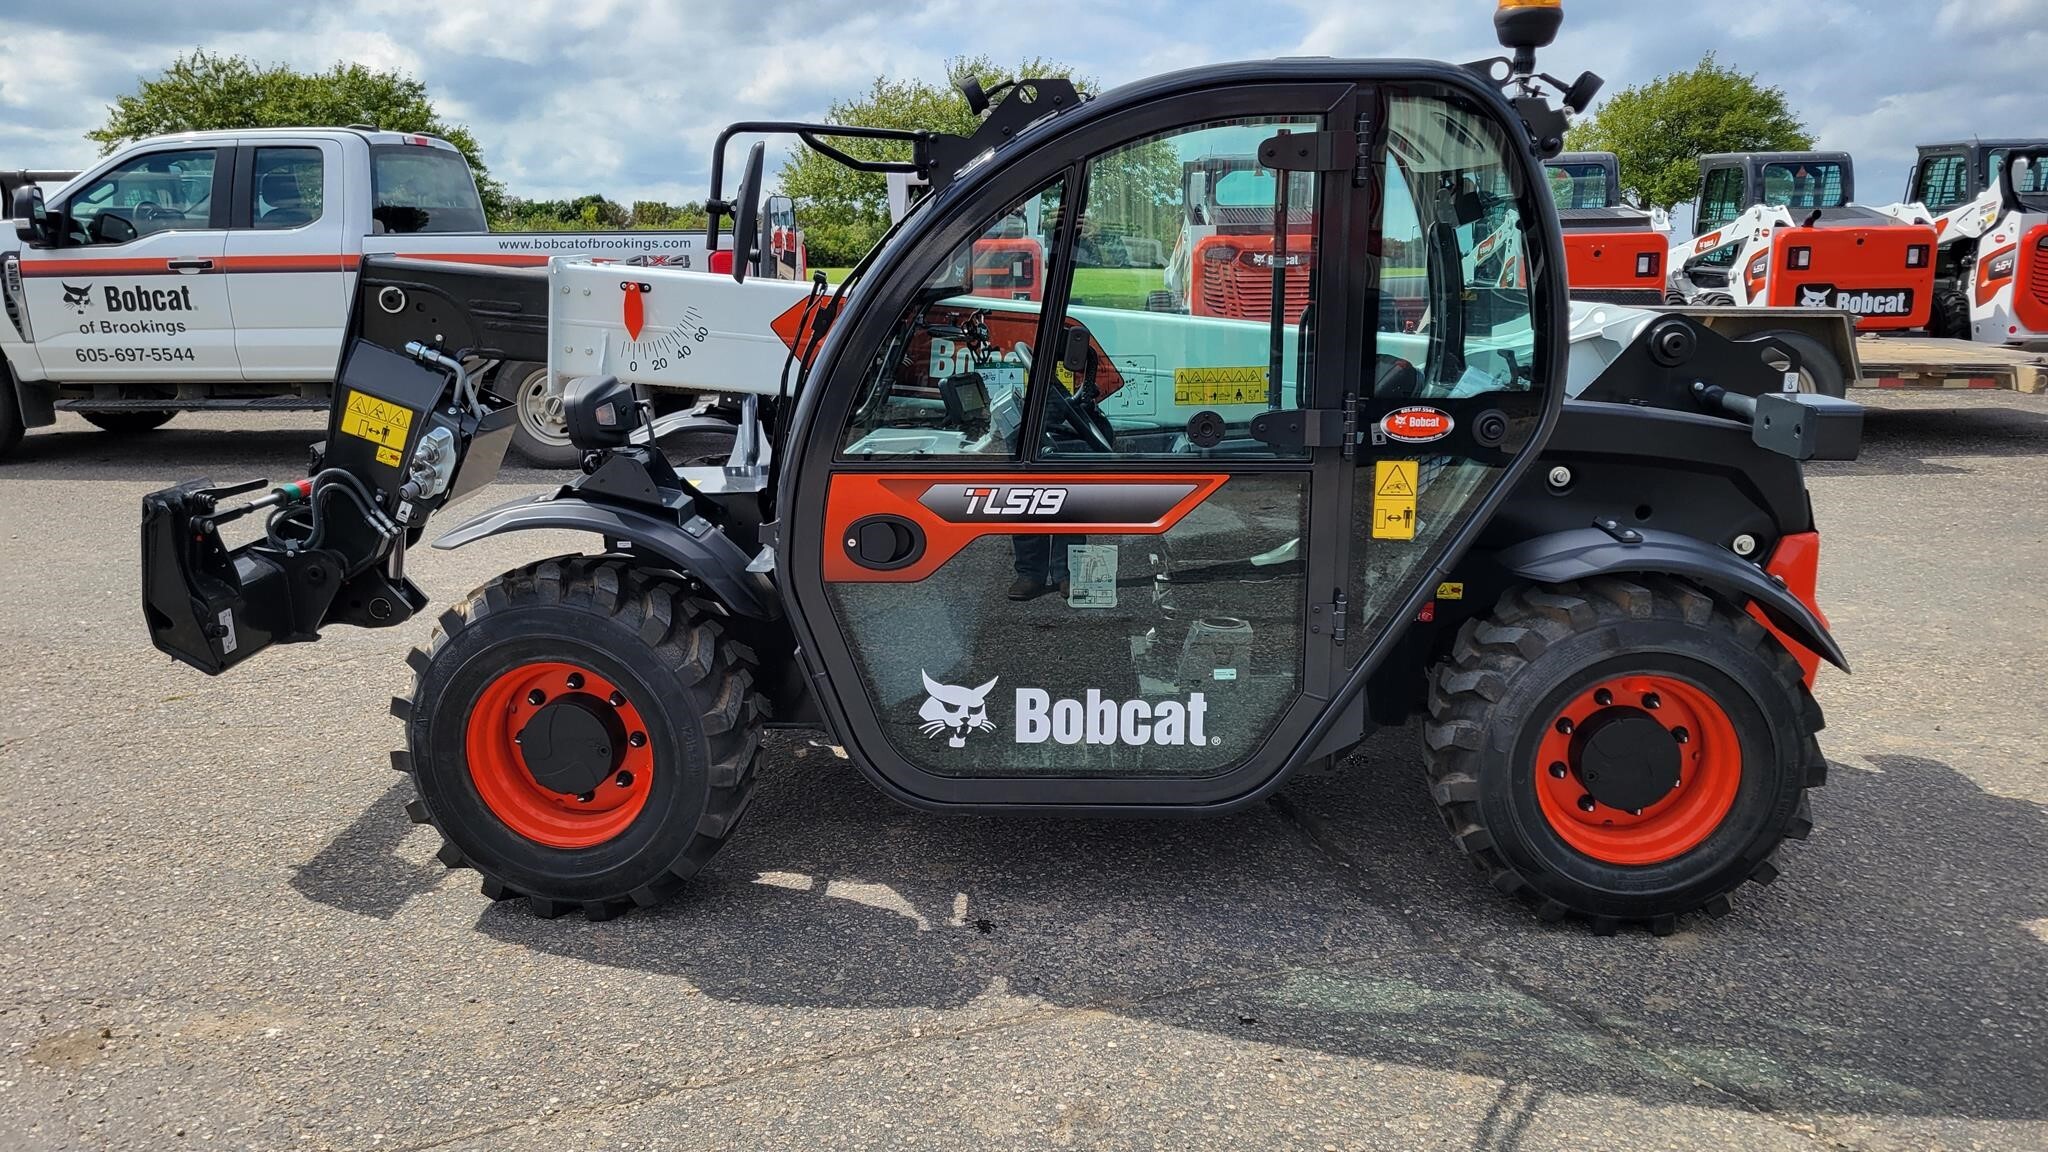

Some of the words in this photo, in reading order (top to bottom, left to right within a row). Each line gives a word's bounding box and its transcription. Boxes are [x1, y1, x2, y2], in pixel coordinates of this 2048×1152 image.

[498, 238, 691, 250] www.bobcatofbrookings.com
[1268, 255, 1299, 265] Bcat
[103, 285, 193, 312] Bobcat
[1836, 292, 1906, 314] Bobcat
[79, 321, 95, 334] of
[101, 320, 186, 336] Brookings
[75, 348, 196, 362] 605-697-5544
[629, 361, 638, 372] 0
[651, 357, 668, 371] 20
[677, 345, 692, 360] 40
[694, 326, 709, 343] 60
[1409, 416, 1440, 428] Bobcat
[964, 488, 1068, 515] TL519
[1015, 687, 1208, 746] Bobcat
